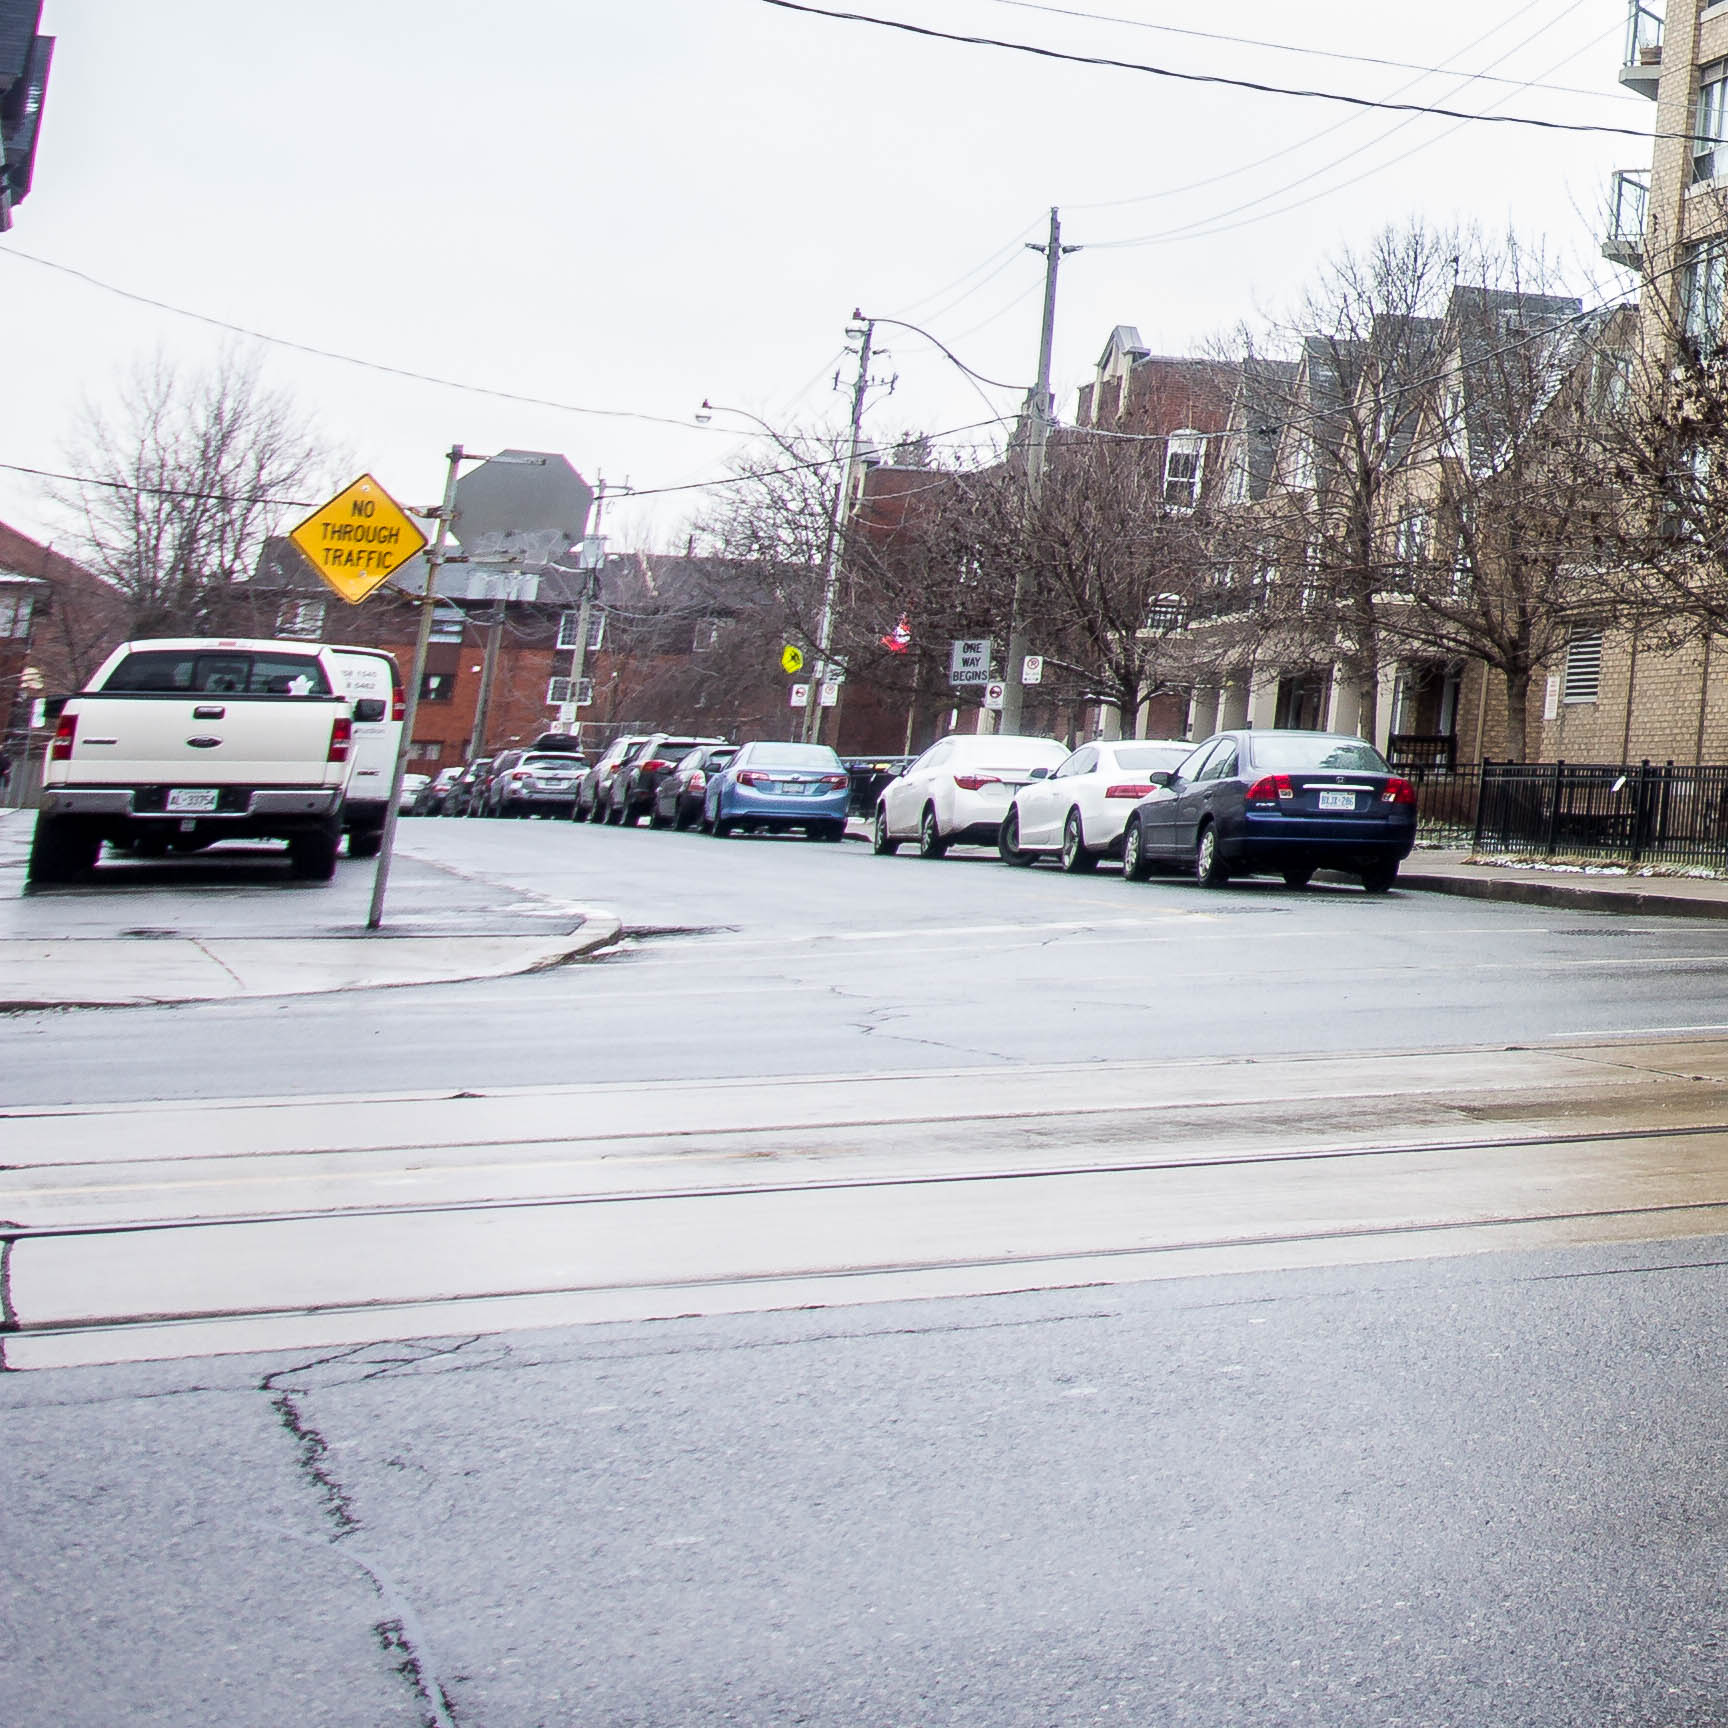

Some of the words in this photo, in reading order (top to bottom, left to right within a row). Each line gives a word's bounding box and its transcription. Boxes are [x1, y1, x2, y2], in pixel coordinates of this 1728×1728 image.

[351, 499, 376, 518] NO
[321, 522, 400, 544] THROUGH
[322, 547, 394, 569] TRAFFIC
[962, 642, 983, 654] ONE
[961, 656, 982, 668] WAY
[952, 670, 988, 682] BEGINS
